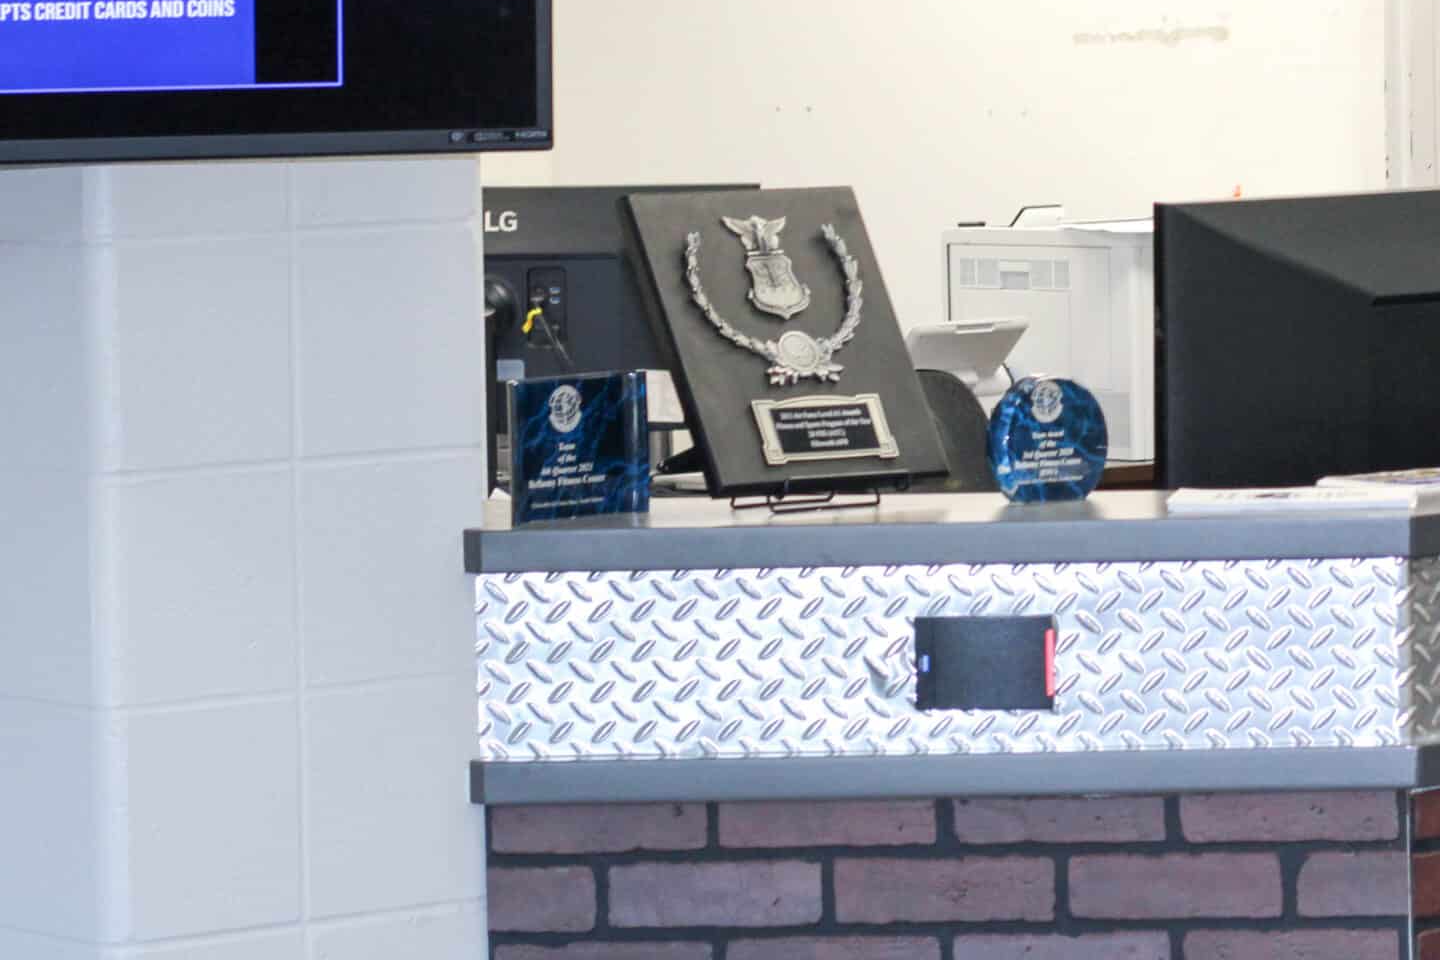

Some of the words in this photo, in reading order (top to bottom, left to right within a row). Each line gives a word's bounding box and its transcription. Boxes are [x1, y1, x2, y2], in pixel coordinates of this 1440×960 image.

[34, 0, 91, 21] CREDIT
[94, 0, 147, 20] CARDS
[150, 0, 184, 19] AND
[484, 209, 518, 233] LG
